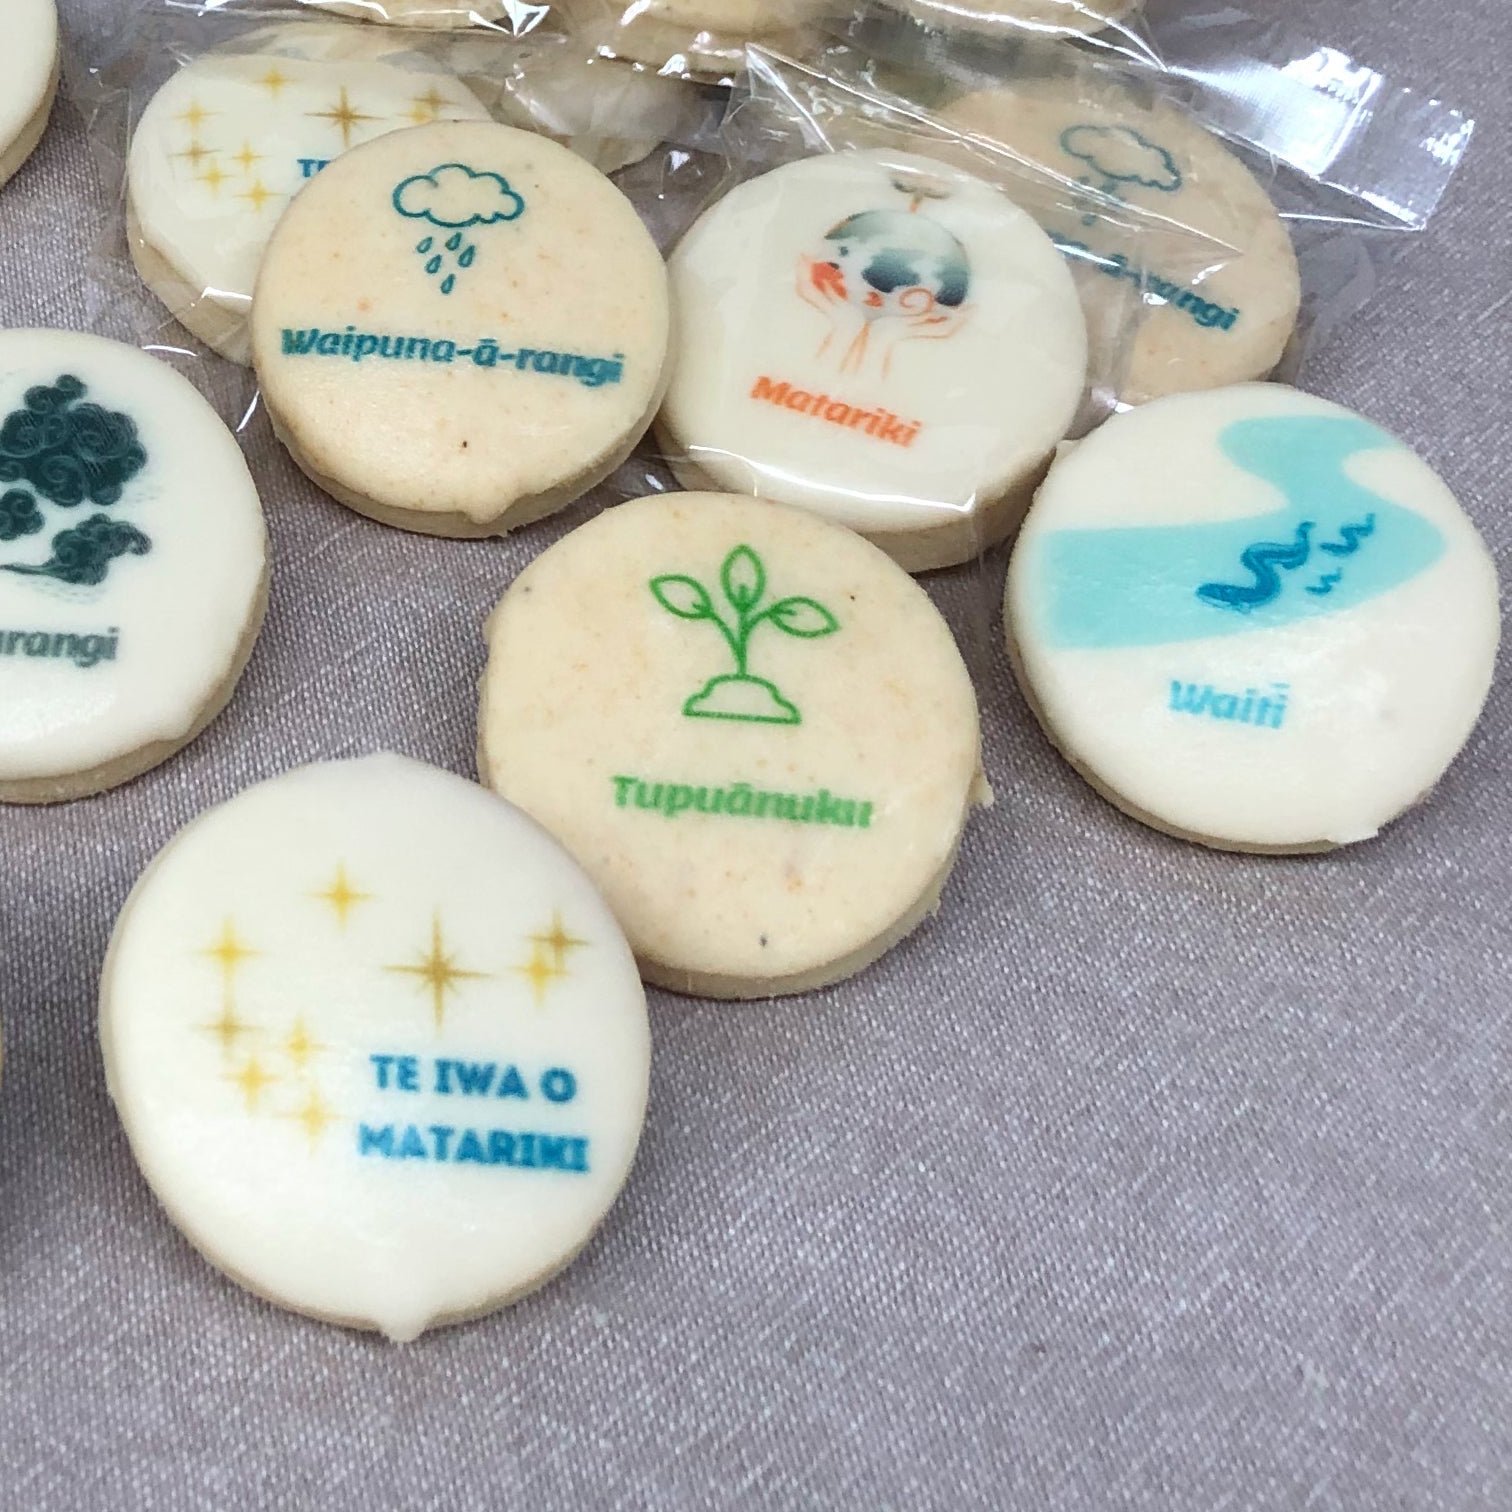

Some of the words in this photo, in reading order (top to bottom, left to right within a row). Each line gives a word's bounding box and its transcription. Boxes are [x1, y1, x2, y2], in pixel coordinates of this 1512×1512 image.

[281, 326, 625, 387] Waipuna-ā-rangi
[750, 375, 921, 449] Matariki
[612, 775, 873, 829] Tupuānuku
[369, 1053, 420, 1092] TE
[434, 1059, 530, 1101] IWA
[539, 1068, 577, 1103] O
[356, 1123, 591, 1174] MATARIKI
